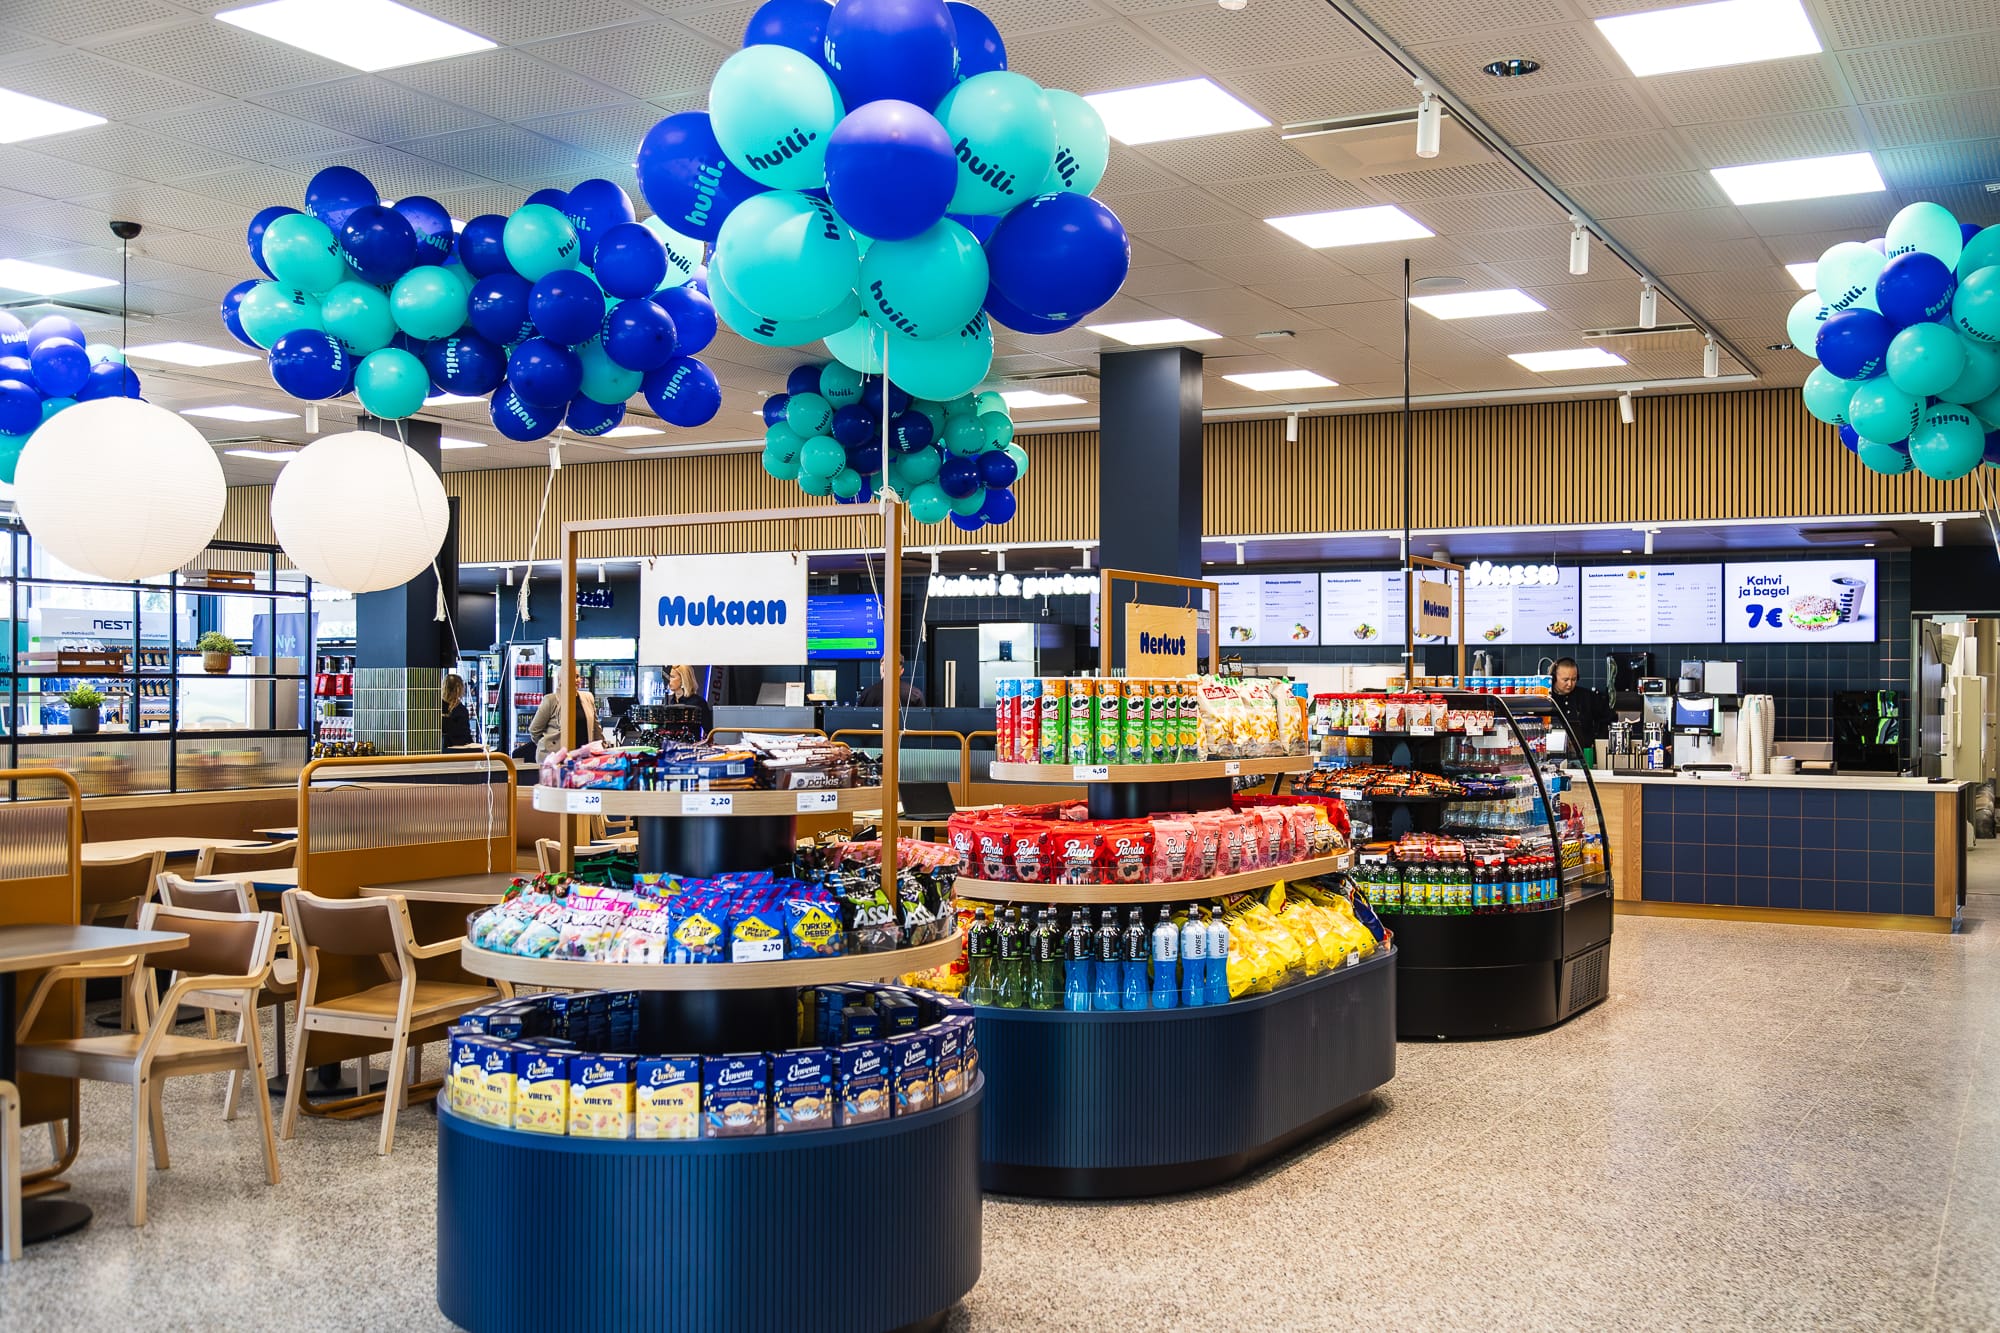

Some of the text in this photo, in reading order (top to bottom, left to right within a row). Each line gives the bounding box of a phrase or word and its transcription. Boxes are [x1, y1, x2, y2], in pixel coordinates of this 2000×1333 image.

[824, 35, 842, 71] ili.
[745, 128, 816, 171] huili.
[955, 137, 1015, 195] huili.
[685, 161, 726, 226] huili.
[415, 227, 450, 253] huili.
[1831, 286, 1867, 312] huili.
[870, 280, 918, 337] huili.
[446, 338, 460, 379] huili.
[662, 366, 691, 400] huili.
[829, 388, 854, 397] huili.
[506, 393, 537, 430] huili.
[1926, 414, 1970, 428] huili.
[897, 427, 911, 452] huili.
[1469, 561, 1560, 587] Kassa
[1747, 575, 1782, 585] Kahvi
[928, 574, 997, 597] Kahvi
[999, 573, 1021, 596] &
[1738, 586, 1790, 598] ja bagel
[658, 595, 787, 626] Mukaan
[1423, 600, 1449, 618] Mukaan
[93, 619, 142, 631] NEST
[276, 634, 296, 653] Nyt
[1140, 631, 1186, 656] Herkut
[808, 777, 840, 788] pätkis
[711, 798, 730, 806] 2,20
[821, 795, 836, 803] 2,20
[980, 837, 1003, 855] Panda
[1014, 839, 1040, 856] Panda
[1062, 839, 1094, 858] Panda
[1116, 838, 1145, 856] Panda
[801, 922, 832, 931] TYRKISK
[805, 930, 829, 938] PEBER
[763, 944, 781, 952] 2,70
[854, 1057, 880, 1075] Elovena
[904, 1048, 926, 1067] Elovena
[527, 1062, 554, 1079] Elovena
[582, 1067, 614, 1084] Elovena
[650, 1068, 685, 1085] Elovena
[718, 1068, 753, 1086] Elovena
[787, 1064, 820, 1081] Elovena
[528, 1092, 553, 1101] VIREYS
[584, 1097, 613, 1106] VIREYS
